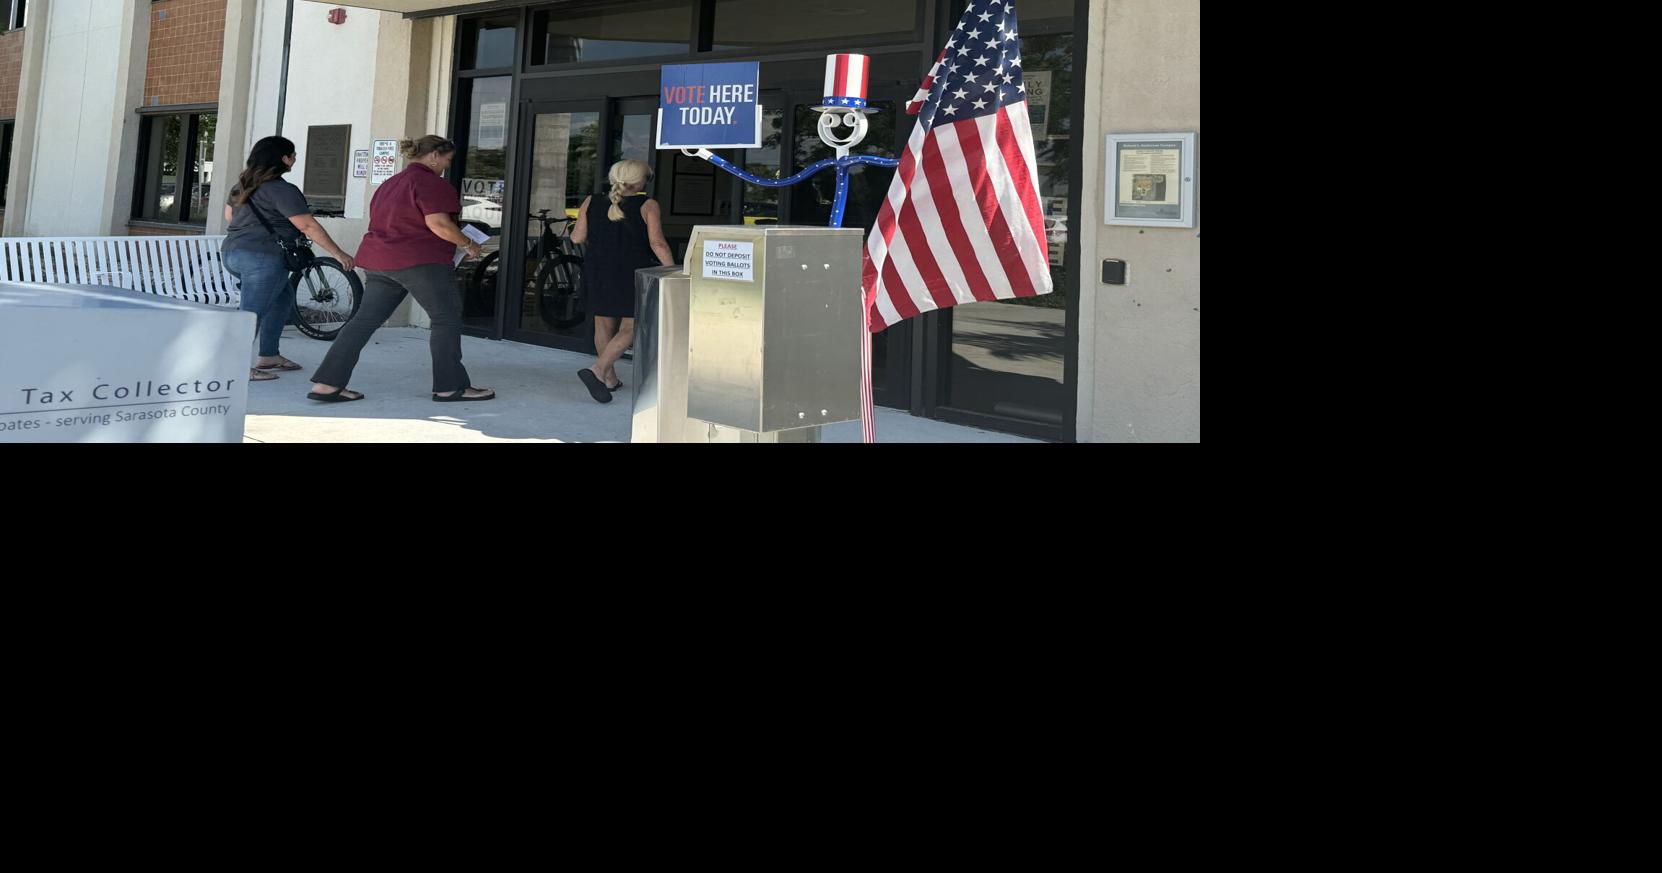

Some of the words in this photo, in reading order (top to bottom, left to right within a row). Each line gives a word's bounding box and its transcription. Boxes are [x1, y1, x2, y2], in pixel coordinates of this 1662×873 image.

[663, 85, 706, 105] VOTE
[709, 84, 754, 103] HERE
[679, 106, 737, 125] TODAY.
[21, 388, 74, 404] Tax
[92, 379, 235, 400] Collector
[56, 412, 111, 426] serving
[116, 408, 177, 422] Sarasota
[181, 404, 232, 417] County
